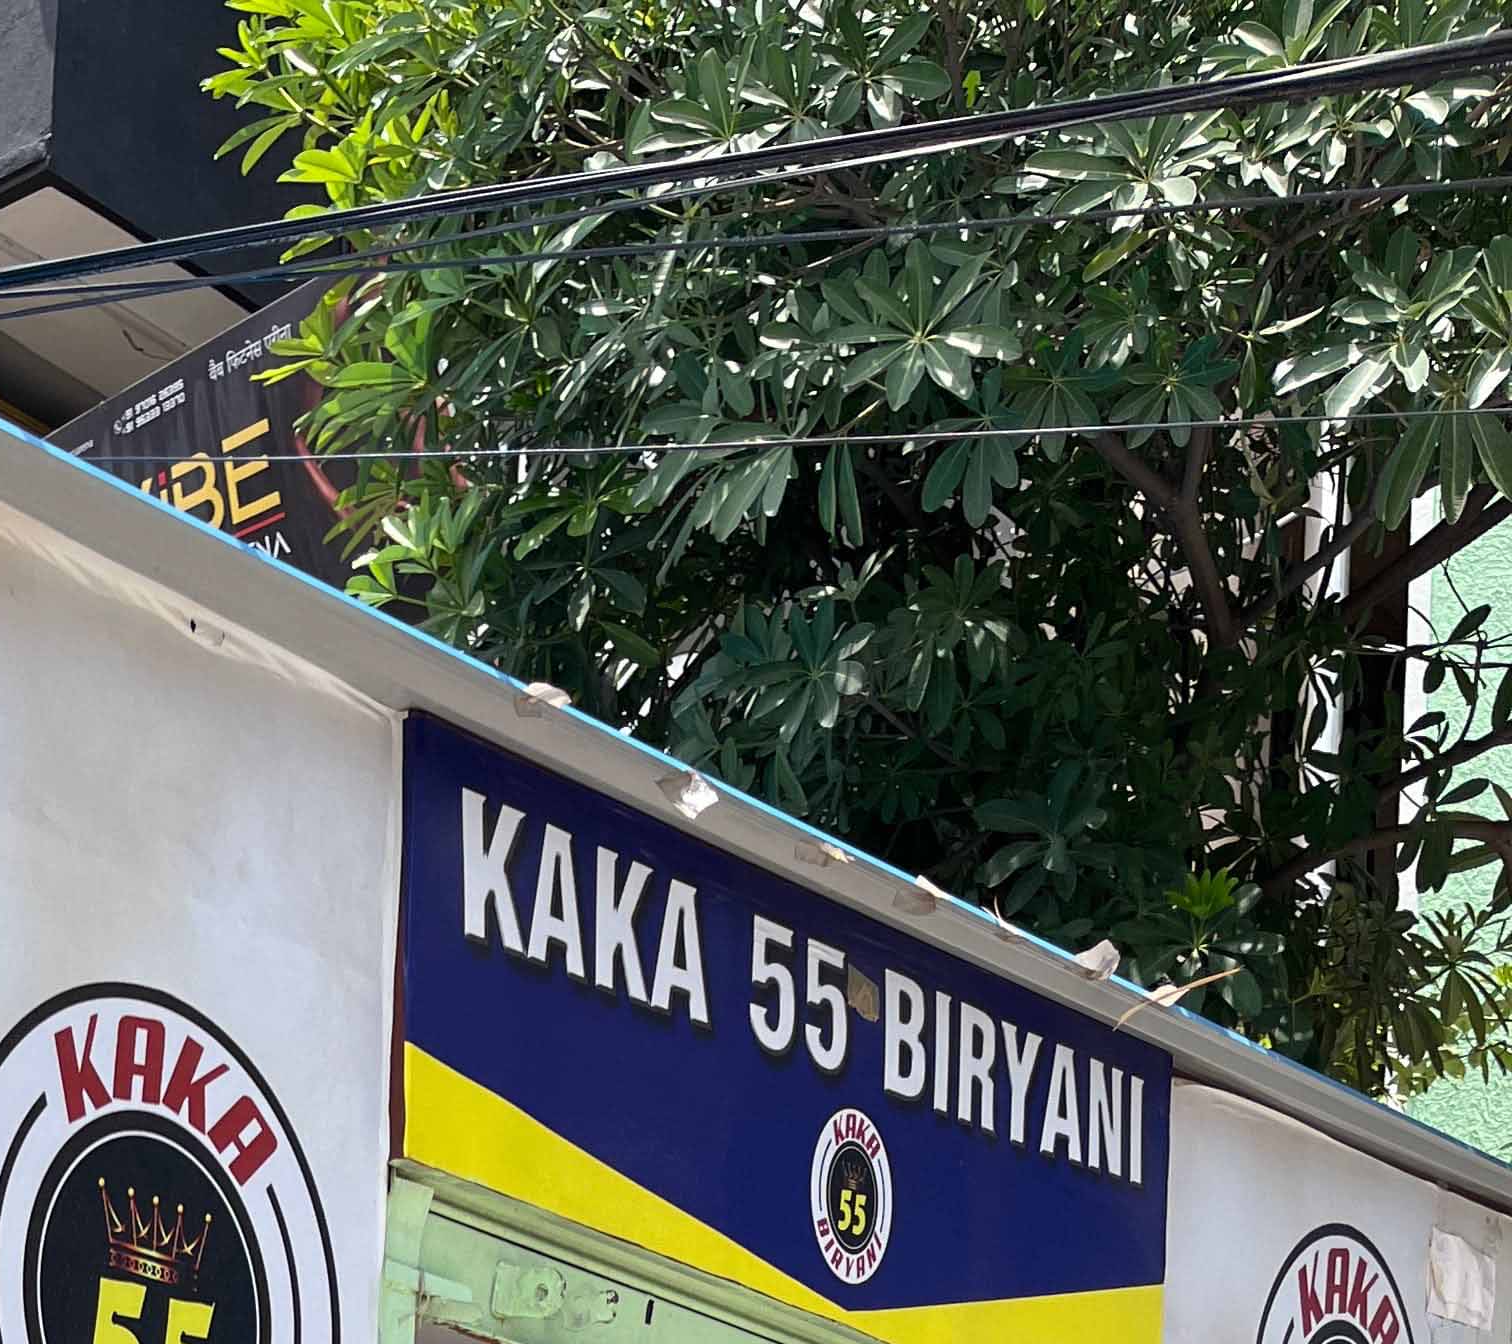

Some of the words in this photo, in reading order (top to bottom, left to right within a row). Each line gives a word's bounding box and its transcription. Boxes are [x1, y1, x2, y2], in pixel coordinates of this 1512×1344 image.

[460, 786, 711, 1028] KAKA
[748, 914, 849, 1075] 55
[882, 967, 1146, 1185] BIRYANI
[54, 1012, 279, 1186] KAKA
[833, 1113, 881, 1160] KAKA
[838, 1189, 867, 1236] 55
[817, 1216, 882, 1279] BIRYANI
